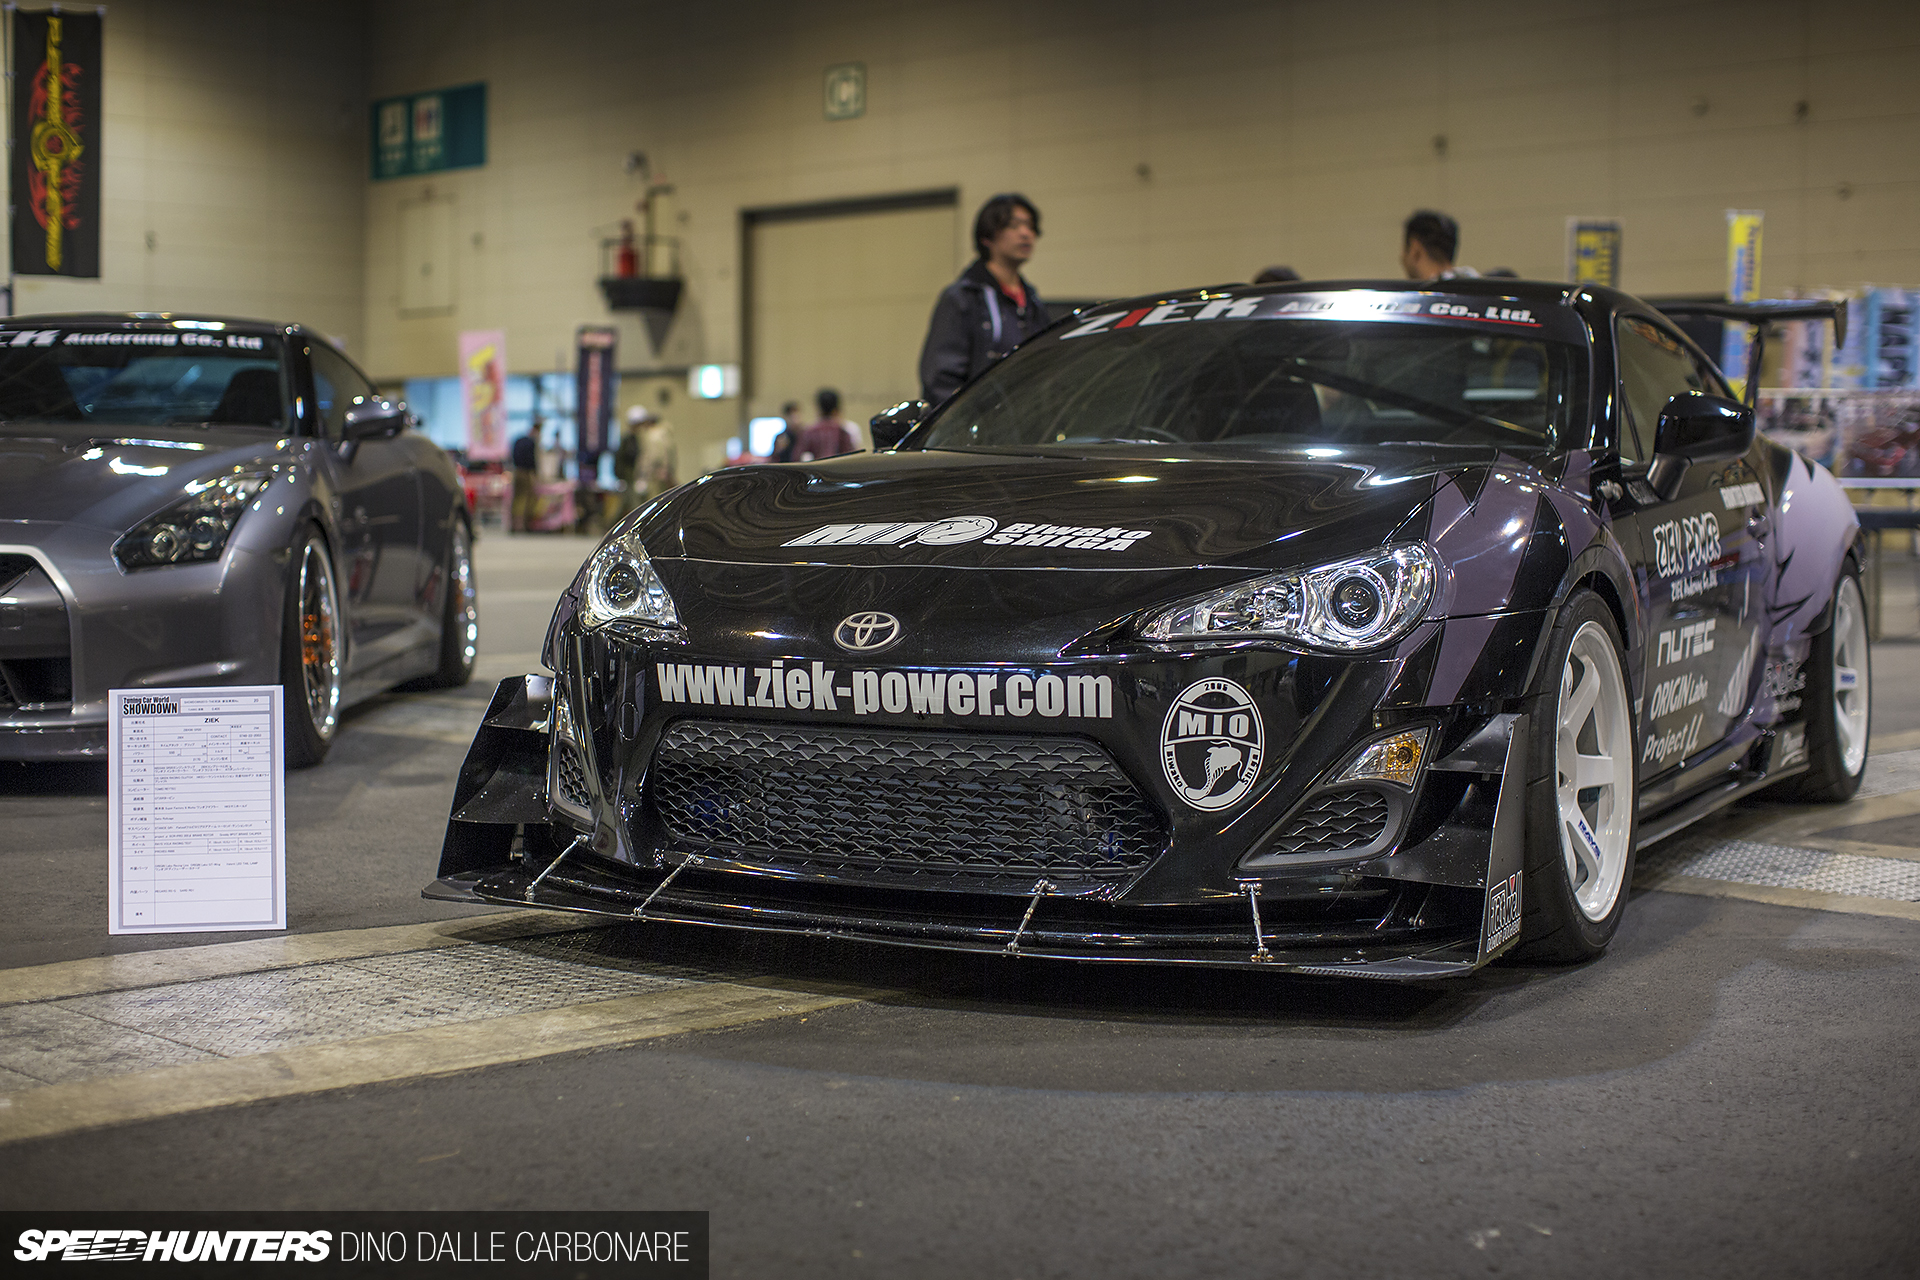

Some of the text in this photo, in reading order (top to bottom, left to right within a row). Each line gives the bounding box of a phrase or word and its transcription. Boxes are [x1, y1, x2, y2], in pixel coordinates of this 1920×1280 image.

[1059, 297, 1265, 340] ZIEK
[982, 533, 1138, 553] SHIGA
[123, 702, 178, 715] SHOWDOWN
[656, 660, 1113, 719] www.ziek-power.com
[1650, 672, 1692, 721] ORIGIN
[1178, 709, 1250, 739] MIO
[1641, 722, 1689, 764] Project
[1166, 750, 1183, 788] Biwako
[1240, 753, 1259, 786] Shiga
